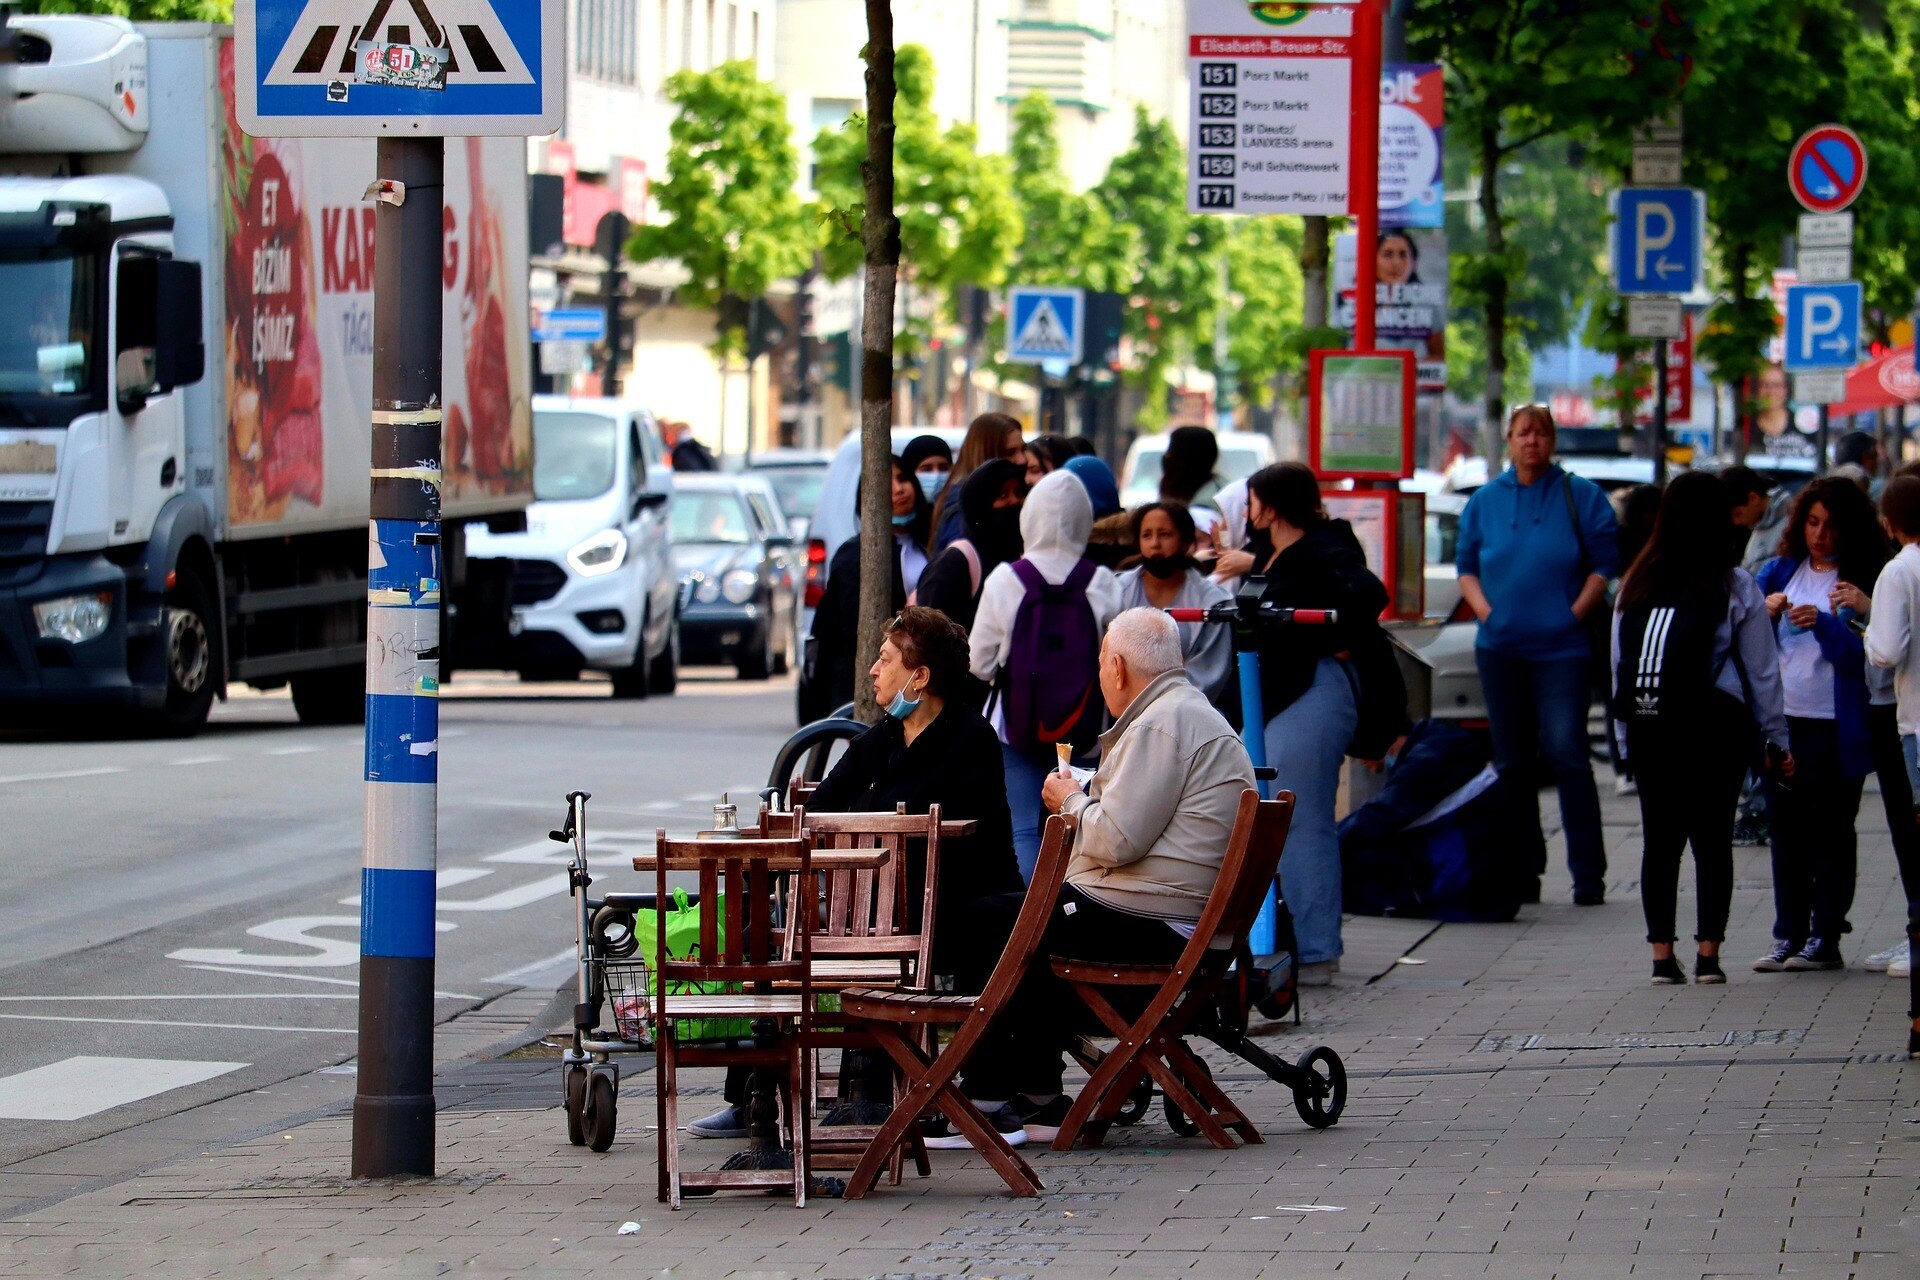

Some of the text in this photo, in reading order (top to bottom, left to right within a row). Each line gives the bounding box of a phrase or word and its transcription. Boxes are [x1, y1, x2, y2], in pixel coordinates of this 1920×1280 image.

[1200, 39, 1348, 54] Elisabeth-Breuer-Str.
[390, 54, 411, 68] 51
[1202, 66, 1310, 84] 151 Porz Markt
[1202, 97, 1309, 115] 152 Porz Markt
[1202, 127, 1235, 145] 153
[1242, 137, 1334, 149] LANXESS arena
[1202, 157, 1234, 175] 159
[1242, 162, 1263, 173] Poll
[262, 179, 281, 227] ET
[1200, 188, 1232, 205] 171
[1293, 192, 1318, 202] Platz
[1636, 203, 1676, 280] P
[1802, 293, 1844, 360] P
